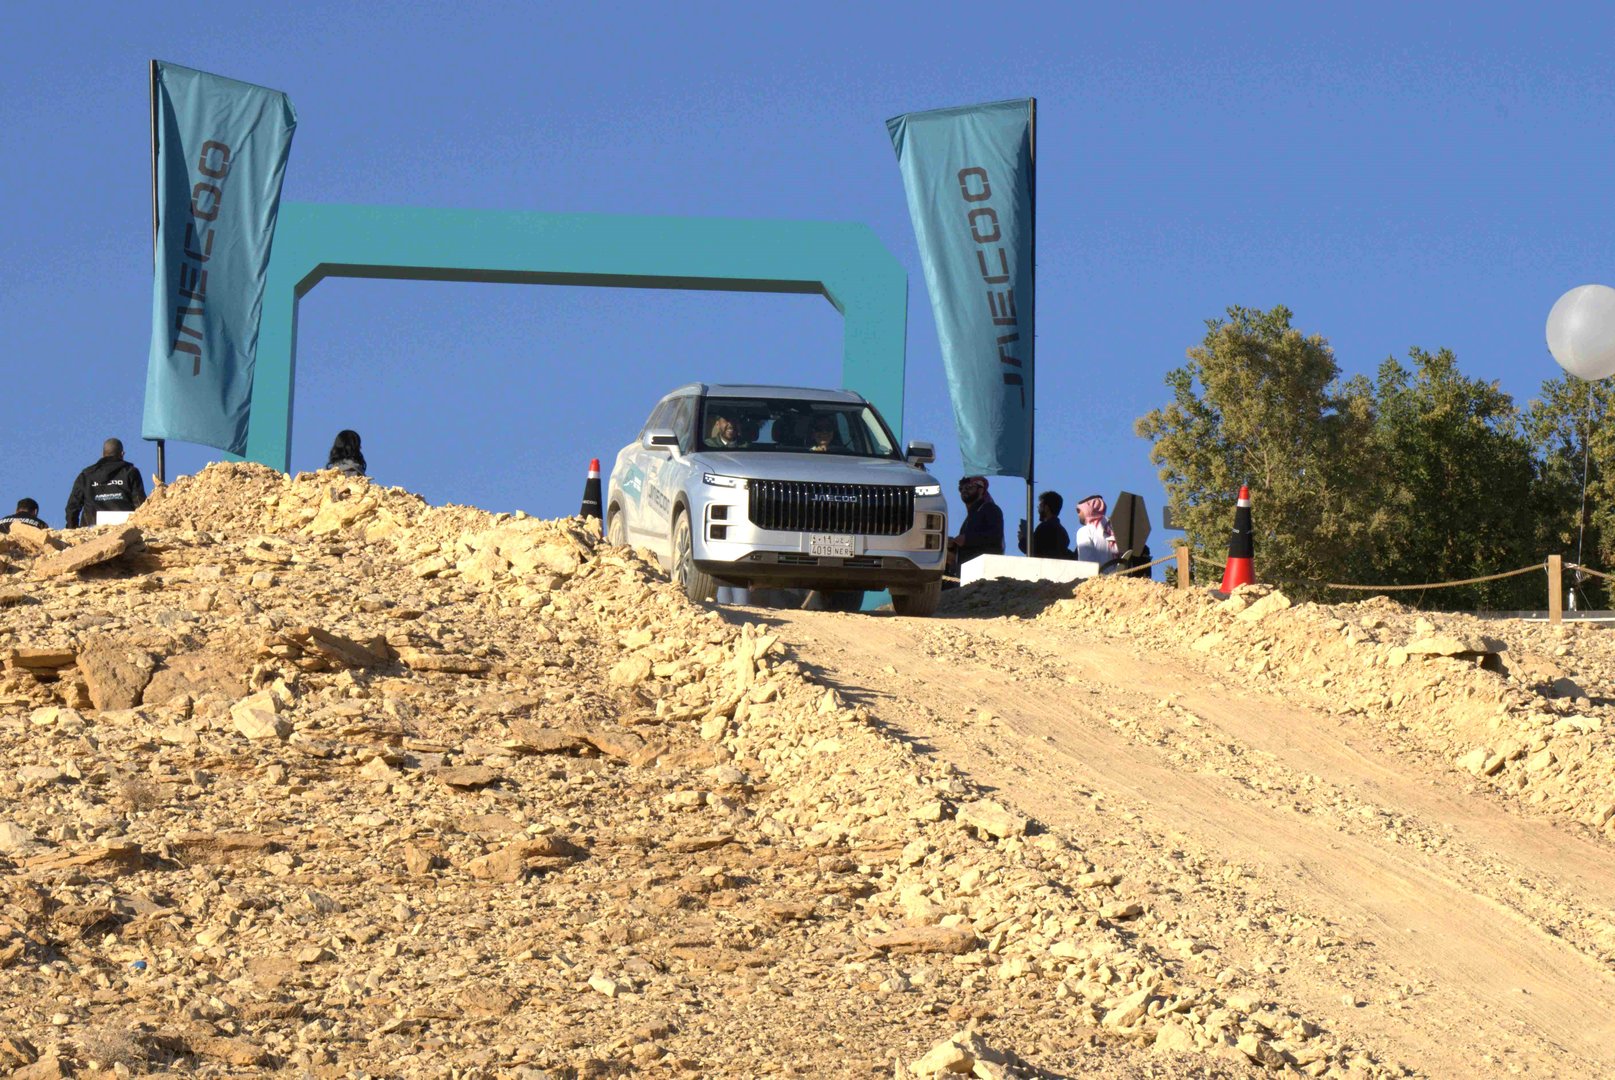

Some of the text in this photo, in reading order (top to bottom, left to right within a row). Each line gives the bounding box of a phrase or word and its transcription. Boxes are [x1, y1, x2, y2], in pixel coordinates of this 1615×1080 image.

[172, 140, 231, 377] JAECOO
[957, 166, 1025, 408] JAECOO
[811, 494, 858, 503] JAECOO
[812, 545, 849, 556] 4019 NER
